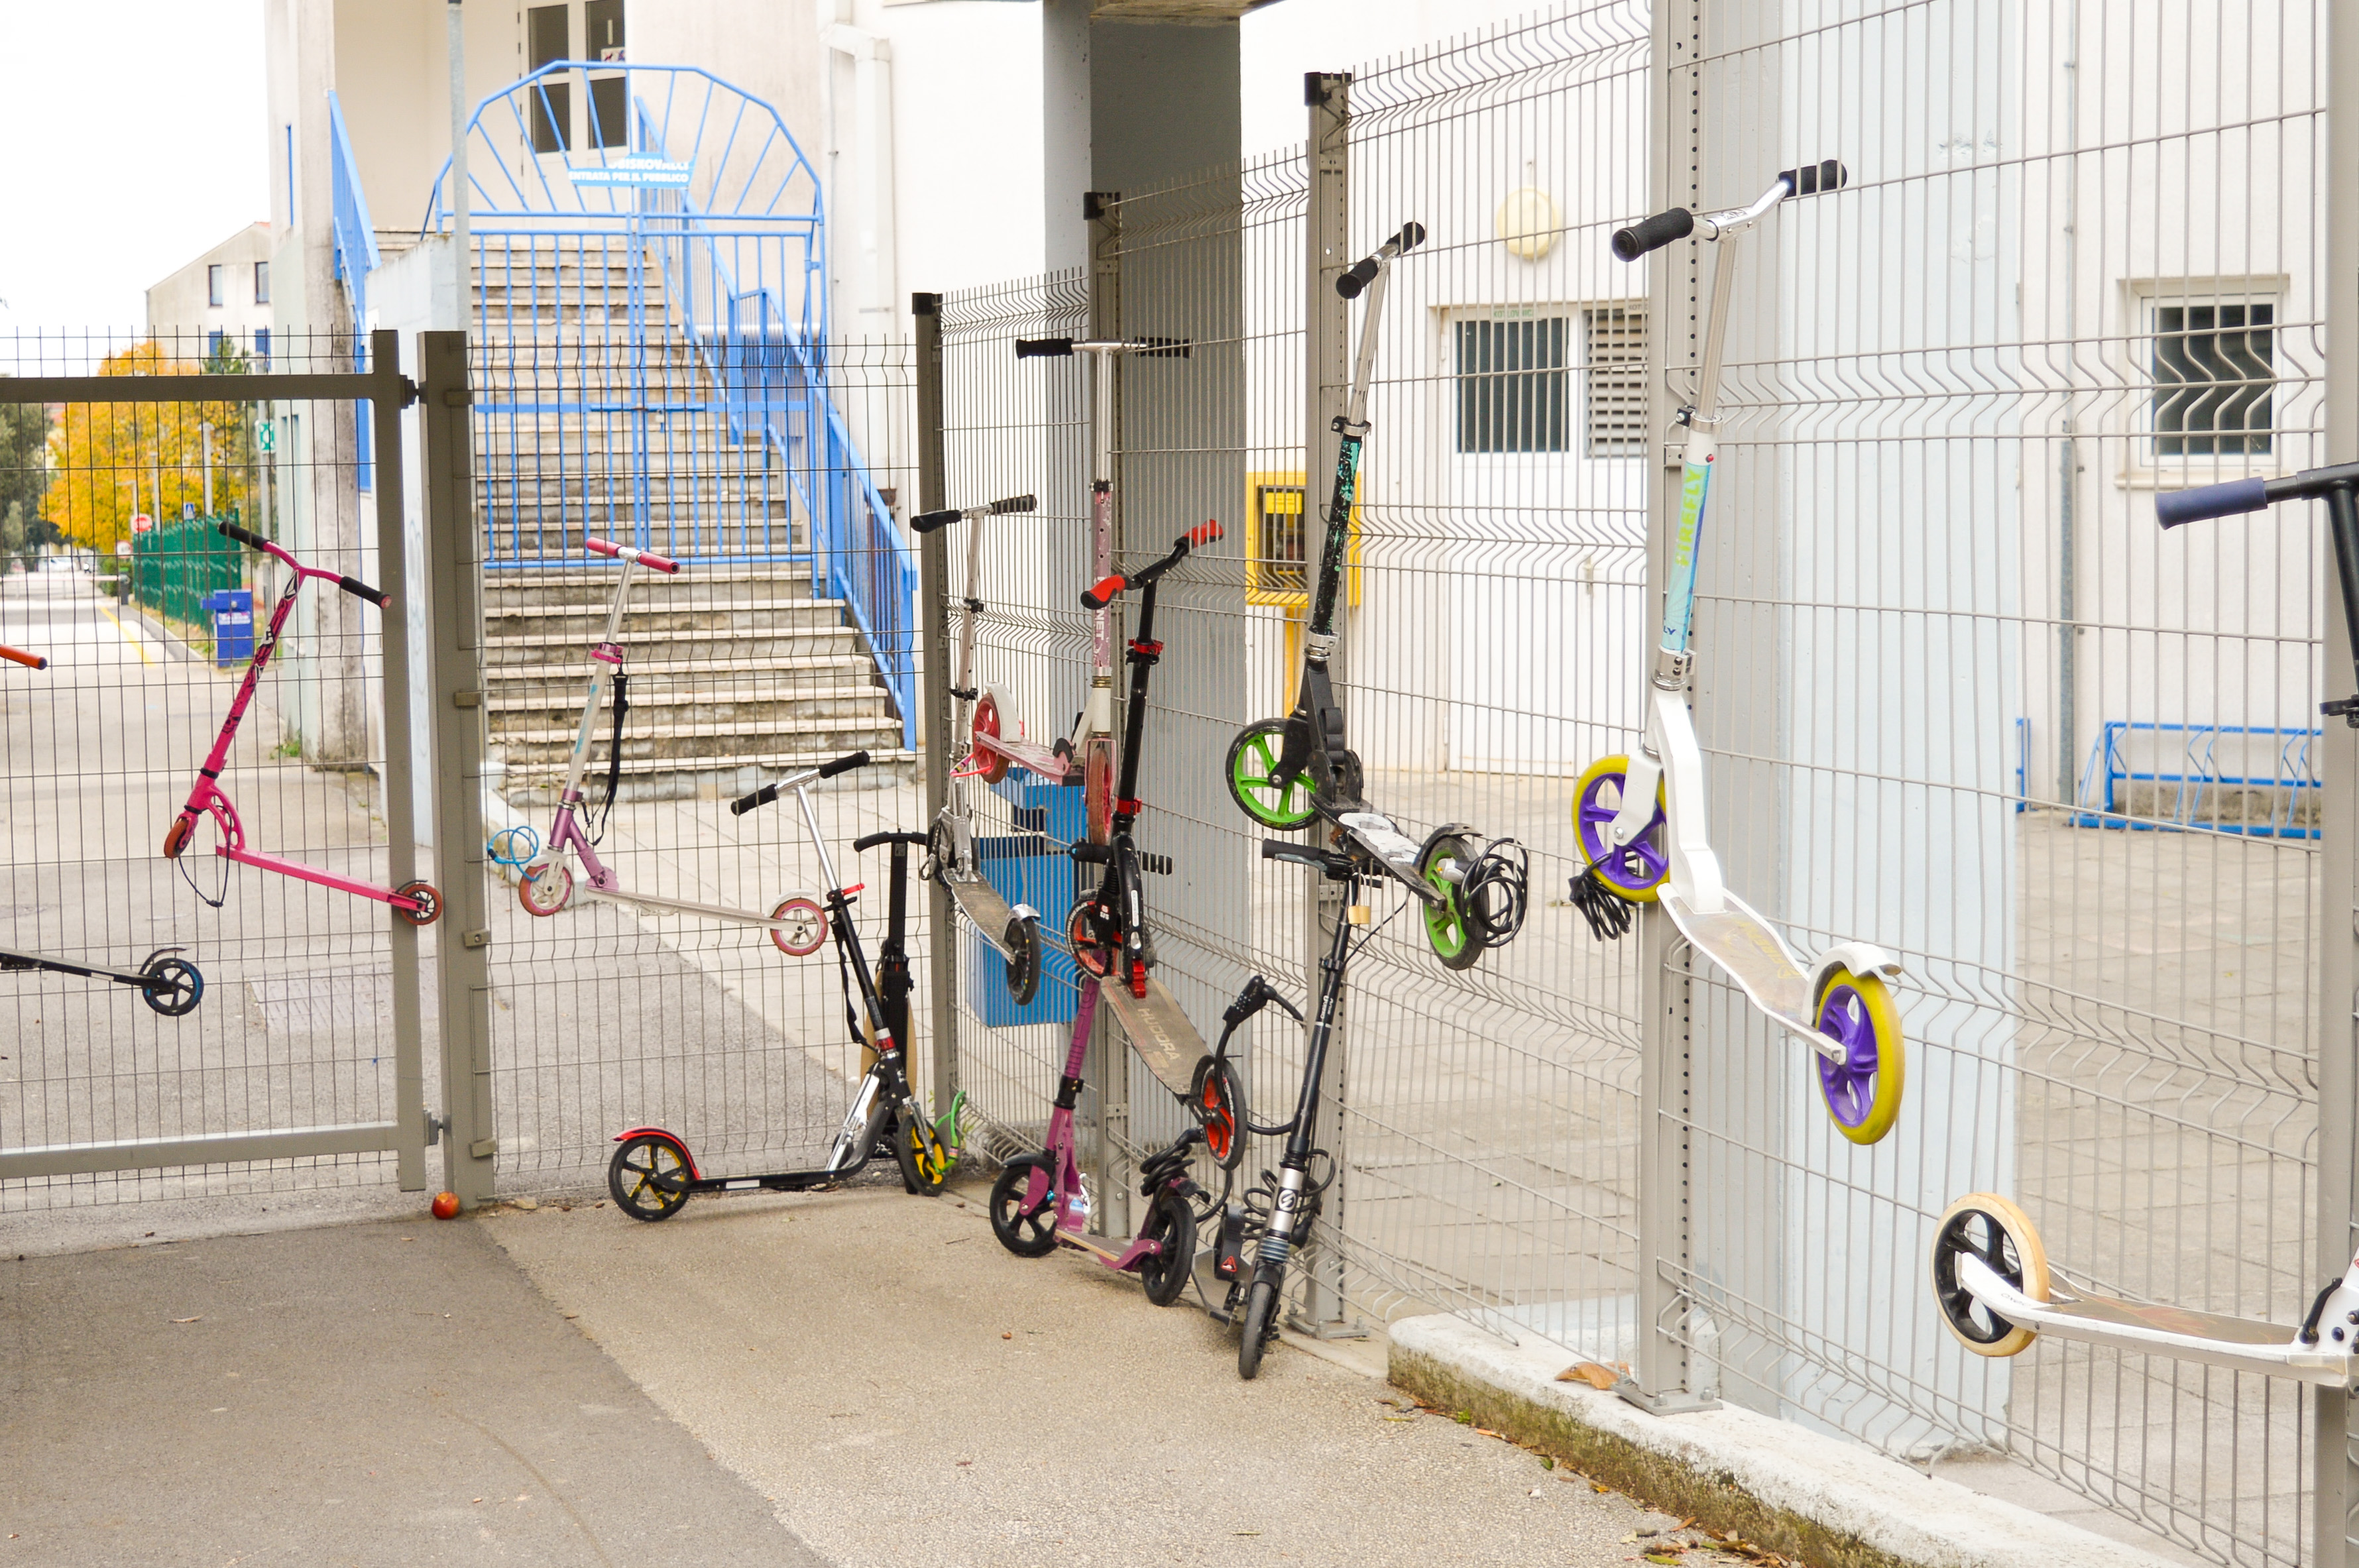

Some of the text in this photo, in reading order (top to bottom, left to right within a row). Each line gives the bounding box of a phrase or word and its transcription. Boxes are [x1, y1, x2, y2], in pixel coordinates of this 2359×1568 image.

[568, 171, 611, 181] ENTRATA
[612, 171, 630, 182] PER
[642, 172, 690, 183] PUBBLICO
[1676, 467, 1703, 567] FIREFLY
[1137, 1007, 1180, 1060] HUDORA
